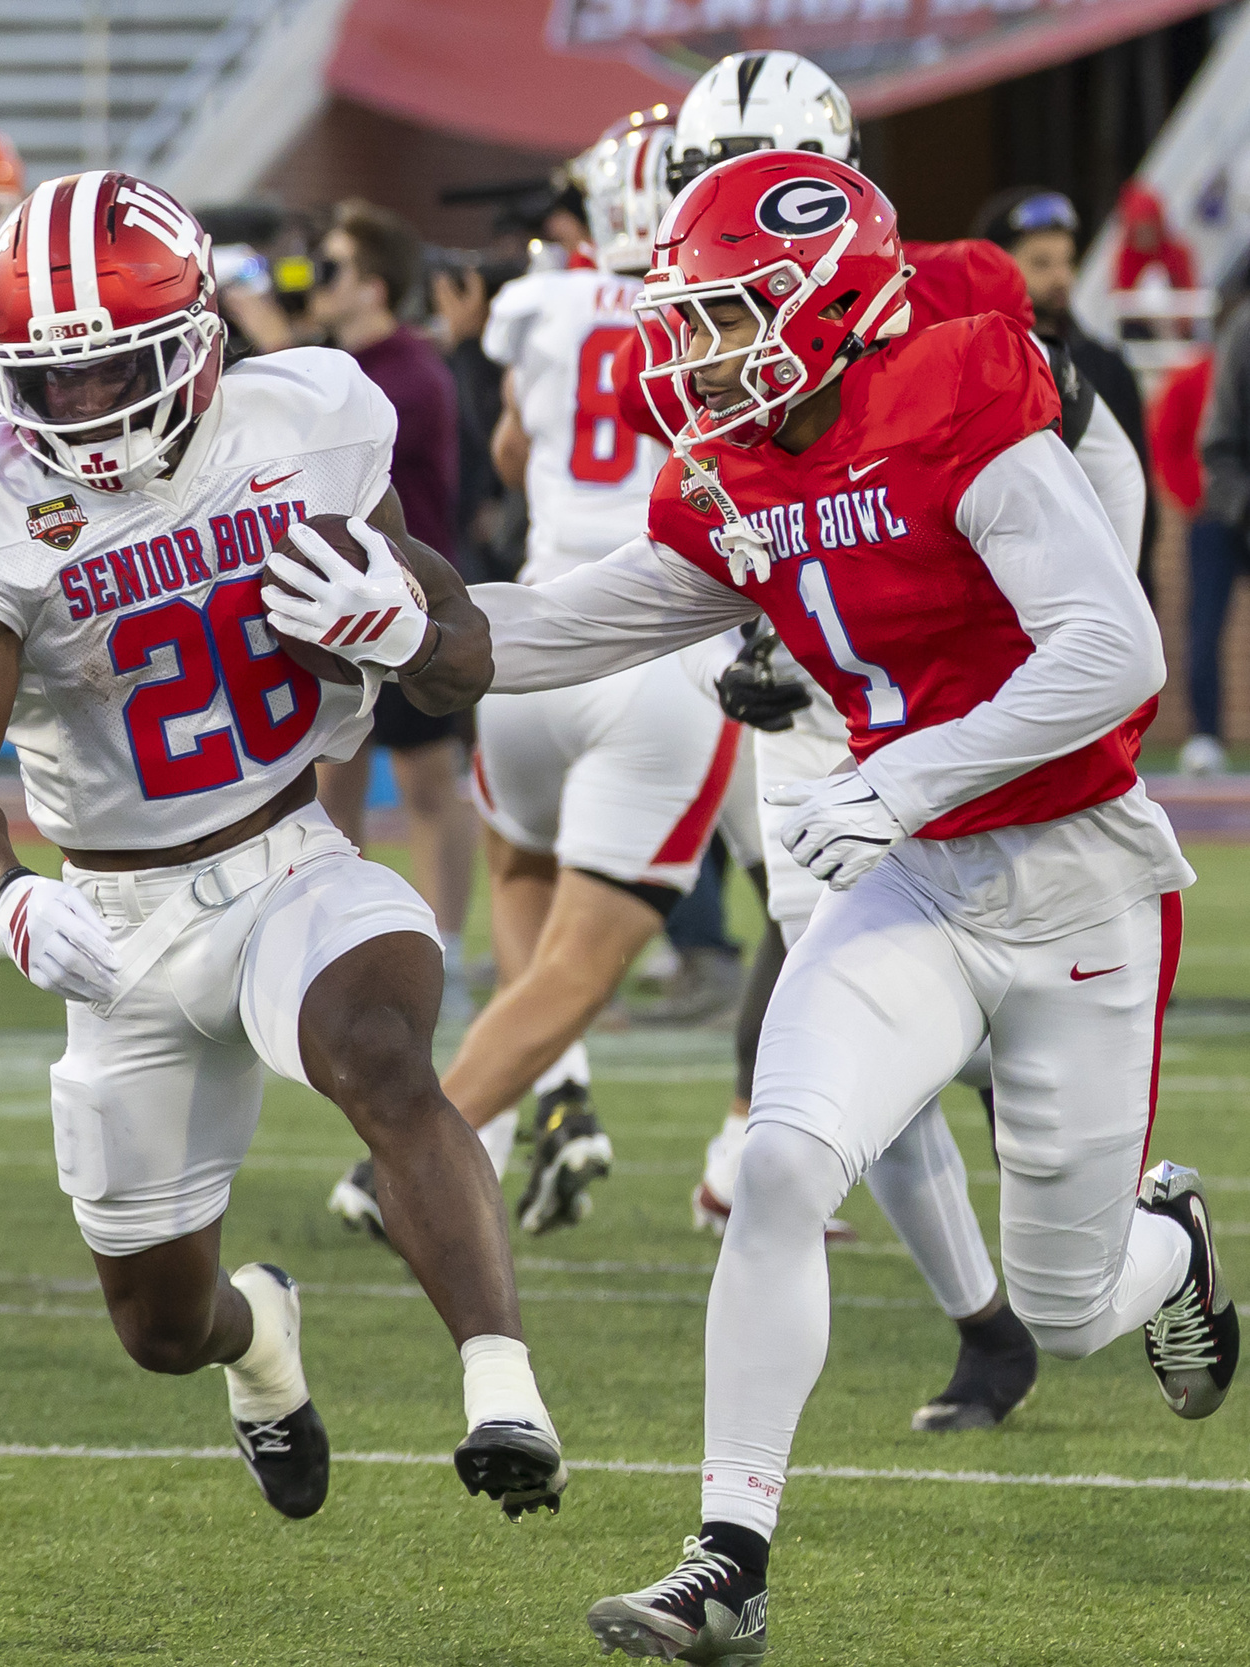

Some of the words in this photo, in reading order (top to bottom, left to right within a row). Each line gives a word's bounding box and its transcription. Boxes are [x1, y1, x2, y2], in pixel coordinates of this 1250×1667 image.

[756, 177, 849, 238] G
[26, 512, 62, 538] SENIOR
[58, 505, 89, 525] BOWL
[707, 486, 739, 525] NXTRND
[816, 486, 909, 549] BOWL
[58, 526, 212, 621] SENIOR
[796, 557, 907, 730] 1
[106, 572, 322, 801] 26
